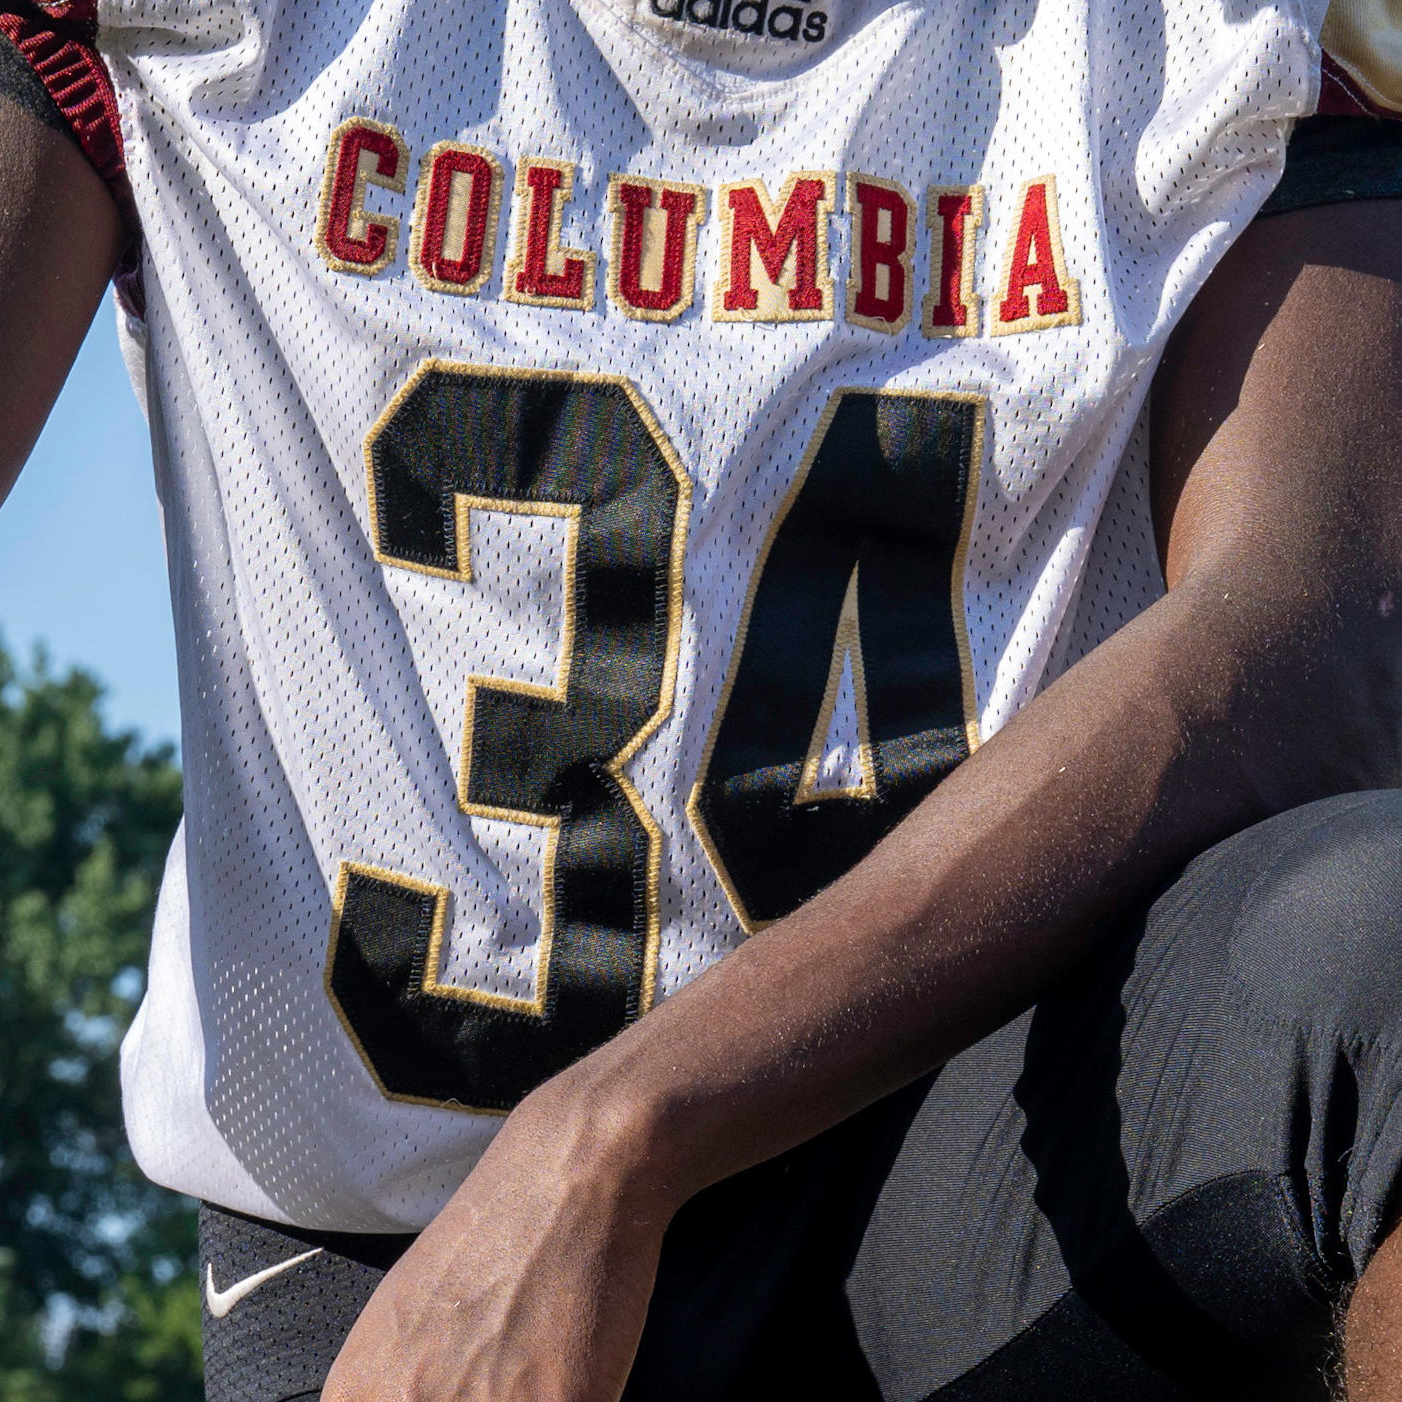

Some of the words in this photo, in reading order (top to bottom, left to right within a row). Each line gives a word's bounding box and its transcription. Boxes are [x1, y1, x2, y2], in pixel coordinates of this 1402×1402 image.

[650, 0, 828, 43] adidas
[314, 116, 1084, 338] COLUMBIA
[323, 358, 990, 1116] 34
